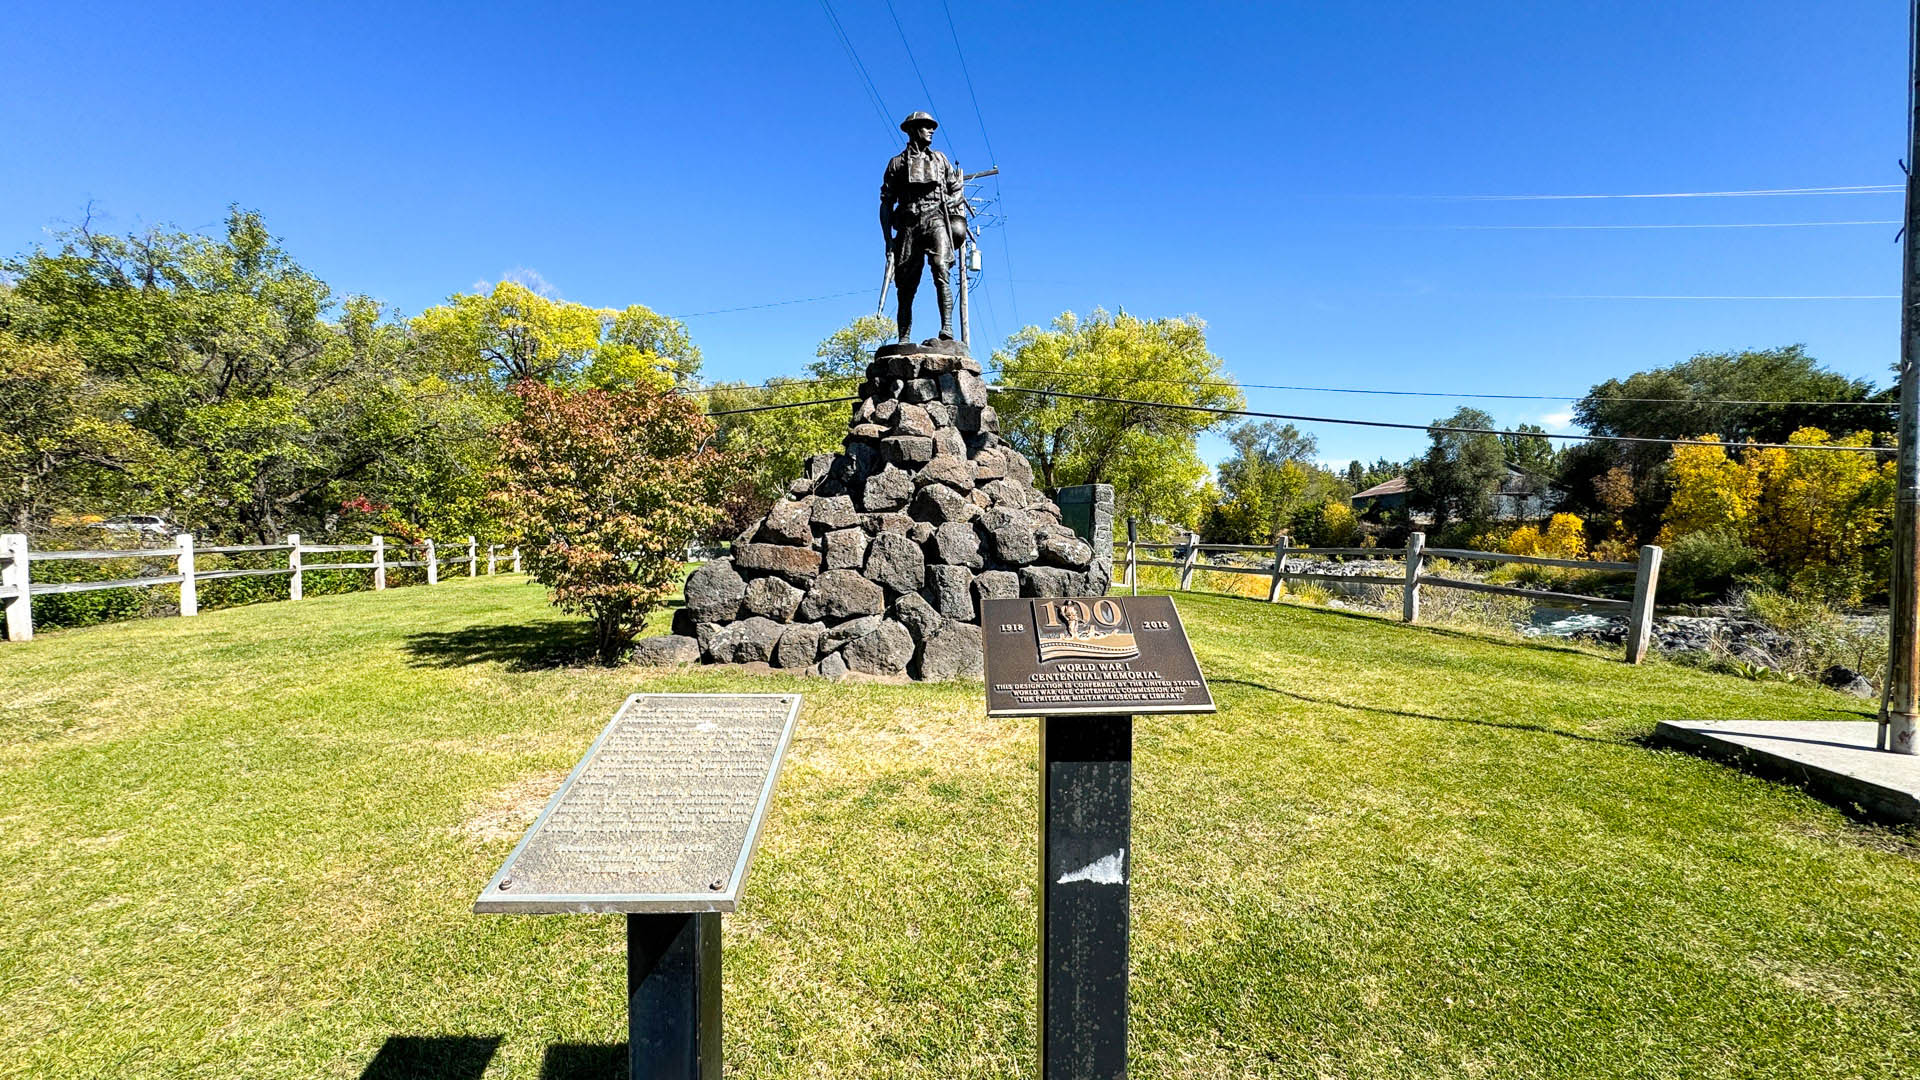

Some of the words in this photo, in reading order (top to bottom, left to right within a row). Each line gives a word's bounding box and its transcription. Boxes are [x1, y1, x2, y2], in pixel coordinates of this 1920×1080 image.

[1000, 623, 1024, 632] 1918
[1143, 621, 1169, 630] 2018
[1057, 663, 1096, 671] WORLD
[1098, 663, 1123, 671] WAR
[1125, 662, 1130, 671] I
[1030, 672, 1100, 681] CENTENNIAL
[1102, 671, 1162, 680] MEMORIAL
